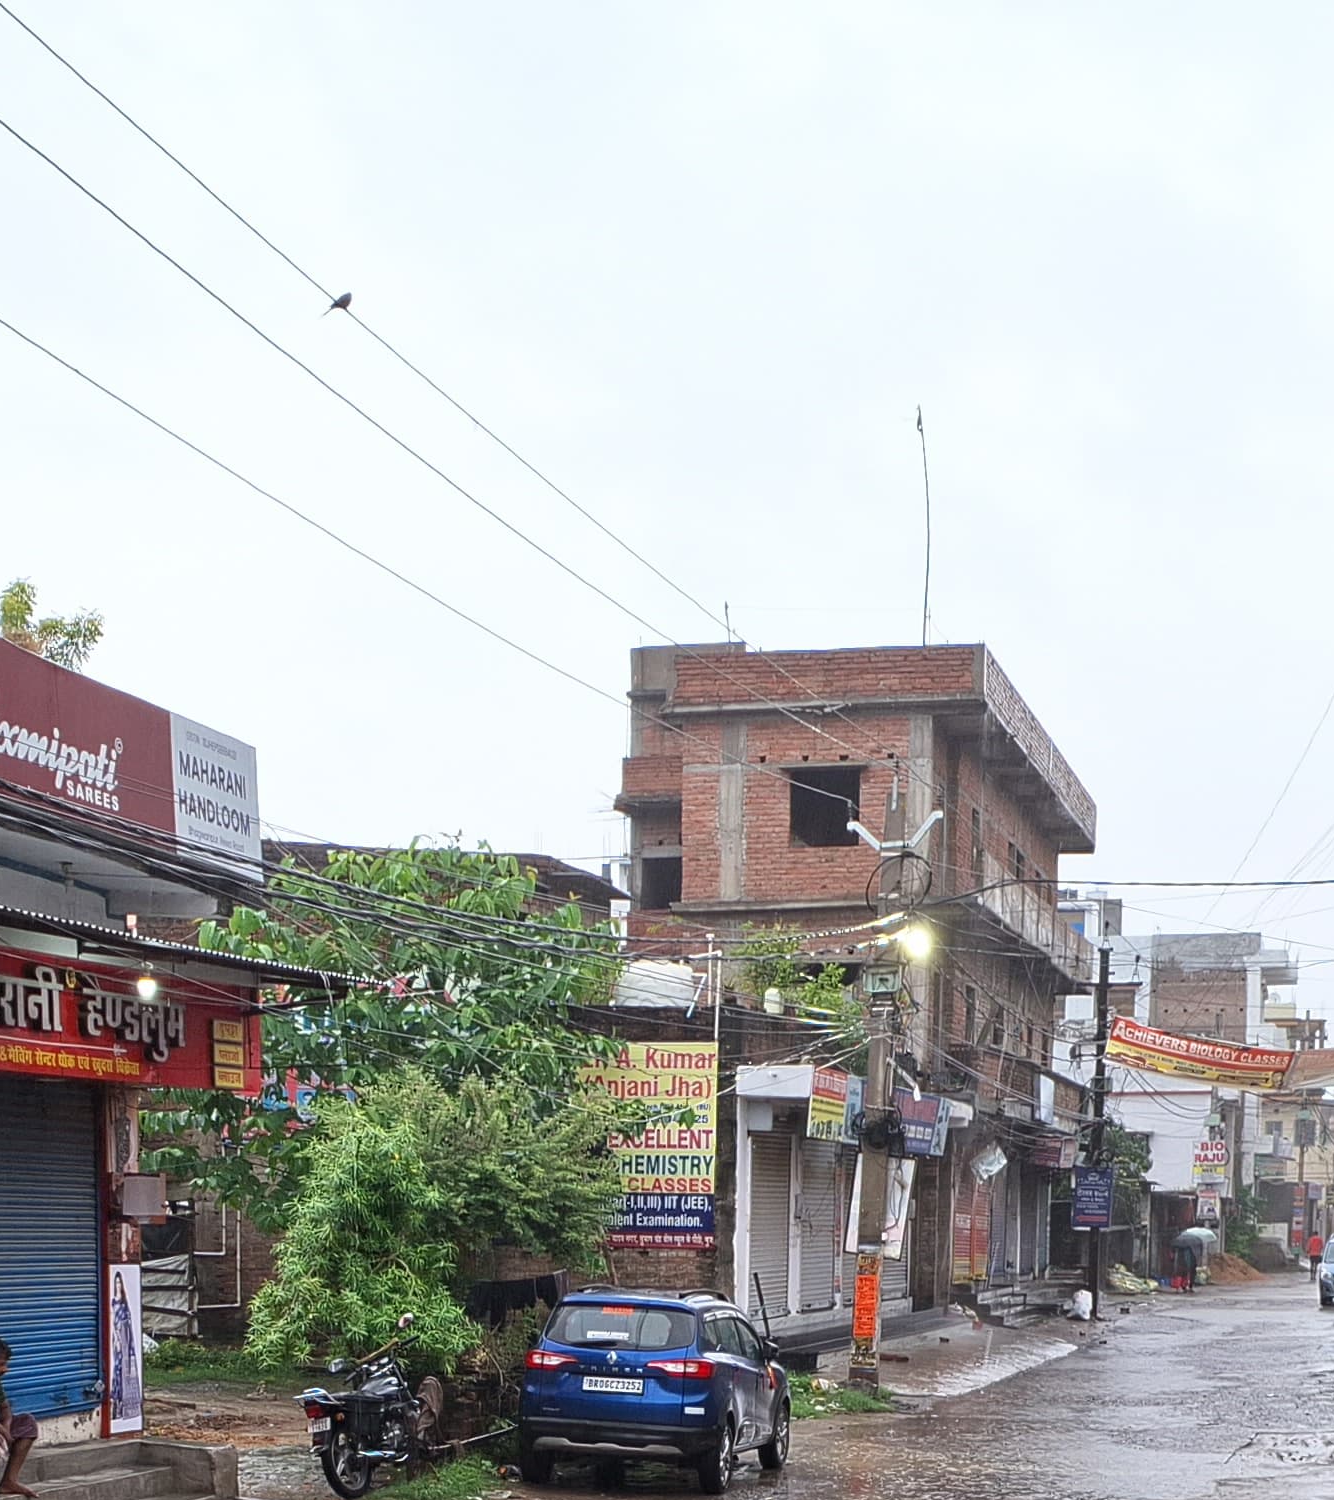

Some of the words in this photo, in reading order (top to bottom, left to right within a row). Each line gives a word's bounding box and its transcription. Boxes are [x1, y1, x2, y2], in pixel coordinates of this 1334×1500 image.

[178, 750, 248, 801] MAHARANI
[66, 779, 121, 812] SAREES
[177, 788, 252, 838] HANDLOOM
[1113, 1020, 1187, 1052] ACHIEVERS
[1188, 1041, 1240, 1062] BIOLOGY
[1240, 1052, 1291, 1067] CLASSES
[616, 1048, 637, 1069] A.
[645, 1048, 716, 1069] Kumar
[665, 1075, 712, 1100] Jha)
[607, 1129, 714, 1149] EXCELLENT
[1200, 1141, 1224, 1152] BIO
[617, 1155, 714, 1176] HEMISTRY
[1194, 1153, 1224, 1163] RAJU
[627, 1177, 712, 1193] CLASSES
[664, 1195, 679, 1210] IIT
[681, 1195, 712, 1213] (JEE),
[636, 1212, 704, 1228] Examination.
